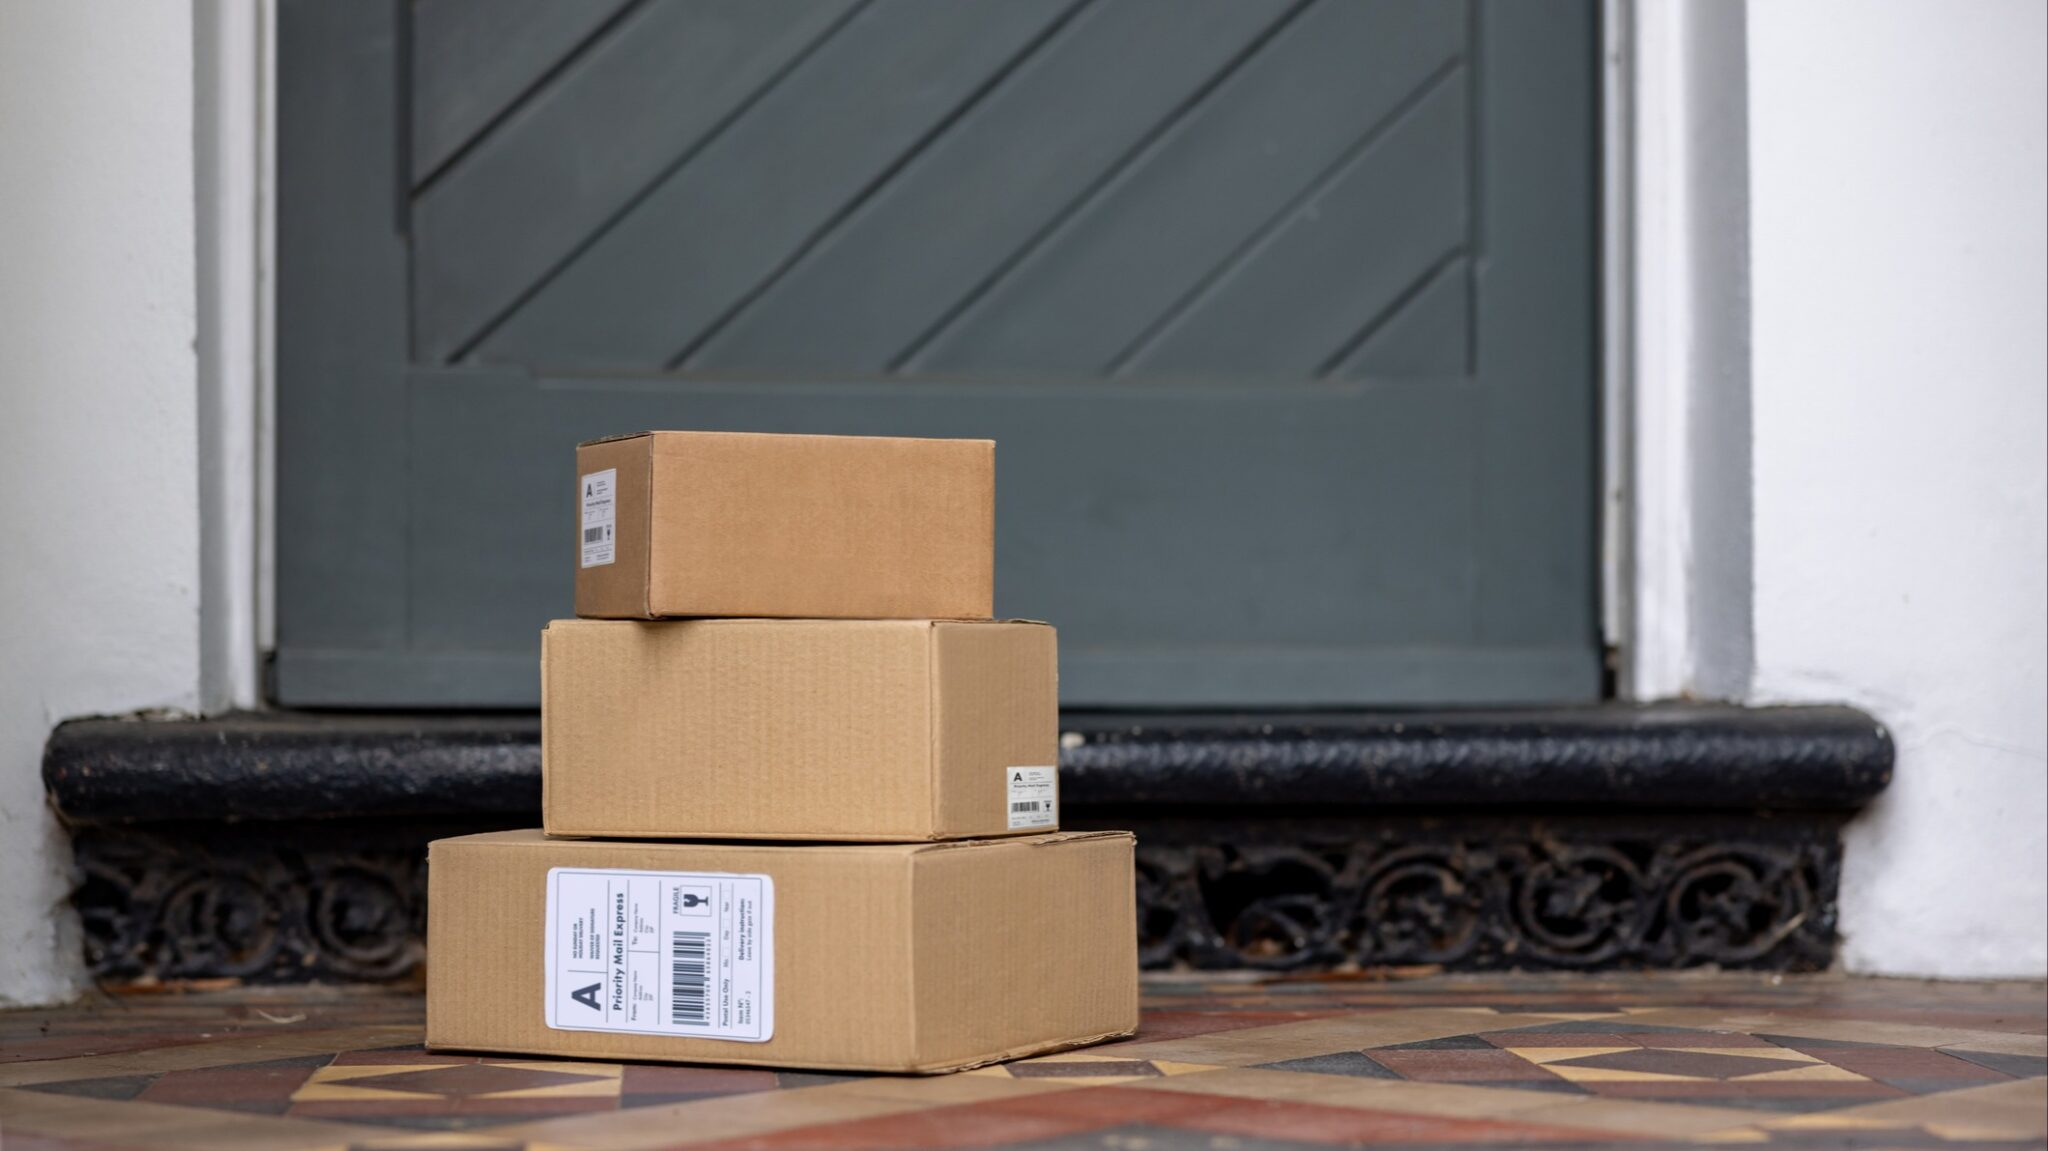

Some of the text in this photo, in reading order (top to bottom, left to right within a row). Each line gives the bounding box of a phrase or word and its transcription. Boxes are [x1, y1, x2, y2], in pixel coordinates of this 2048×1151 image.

[586, 483, 593, 498] A
[1013, 772, 1023, 782] A
[613, 893, 626, 1010] Priority Mail Express
[738, 934, 746, 960] Delivery
[722, 978, 730, 994] Only
[571, 983, 601, 1011] A
